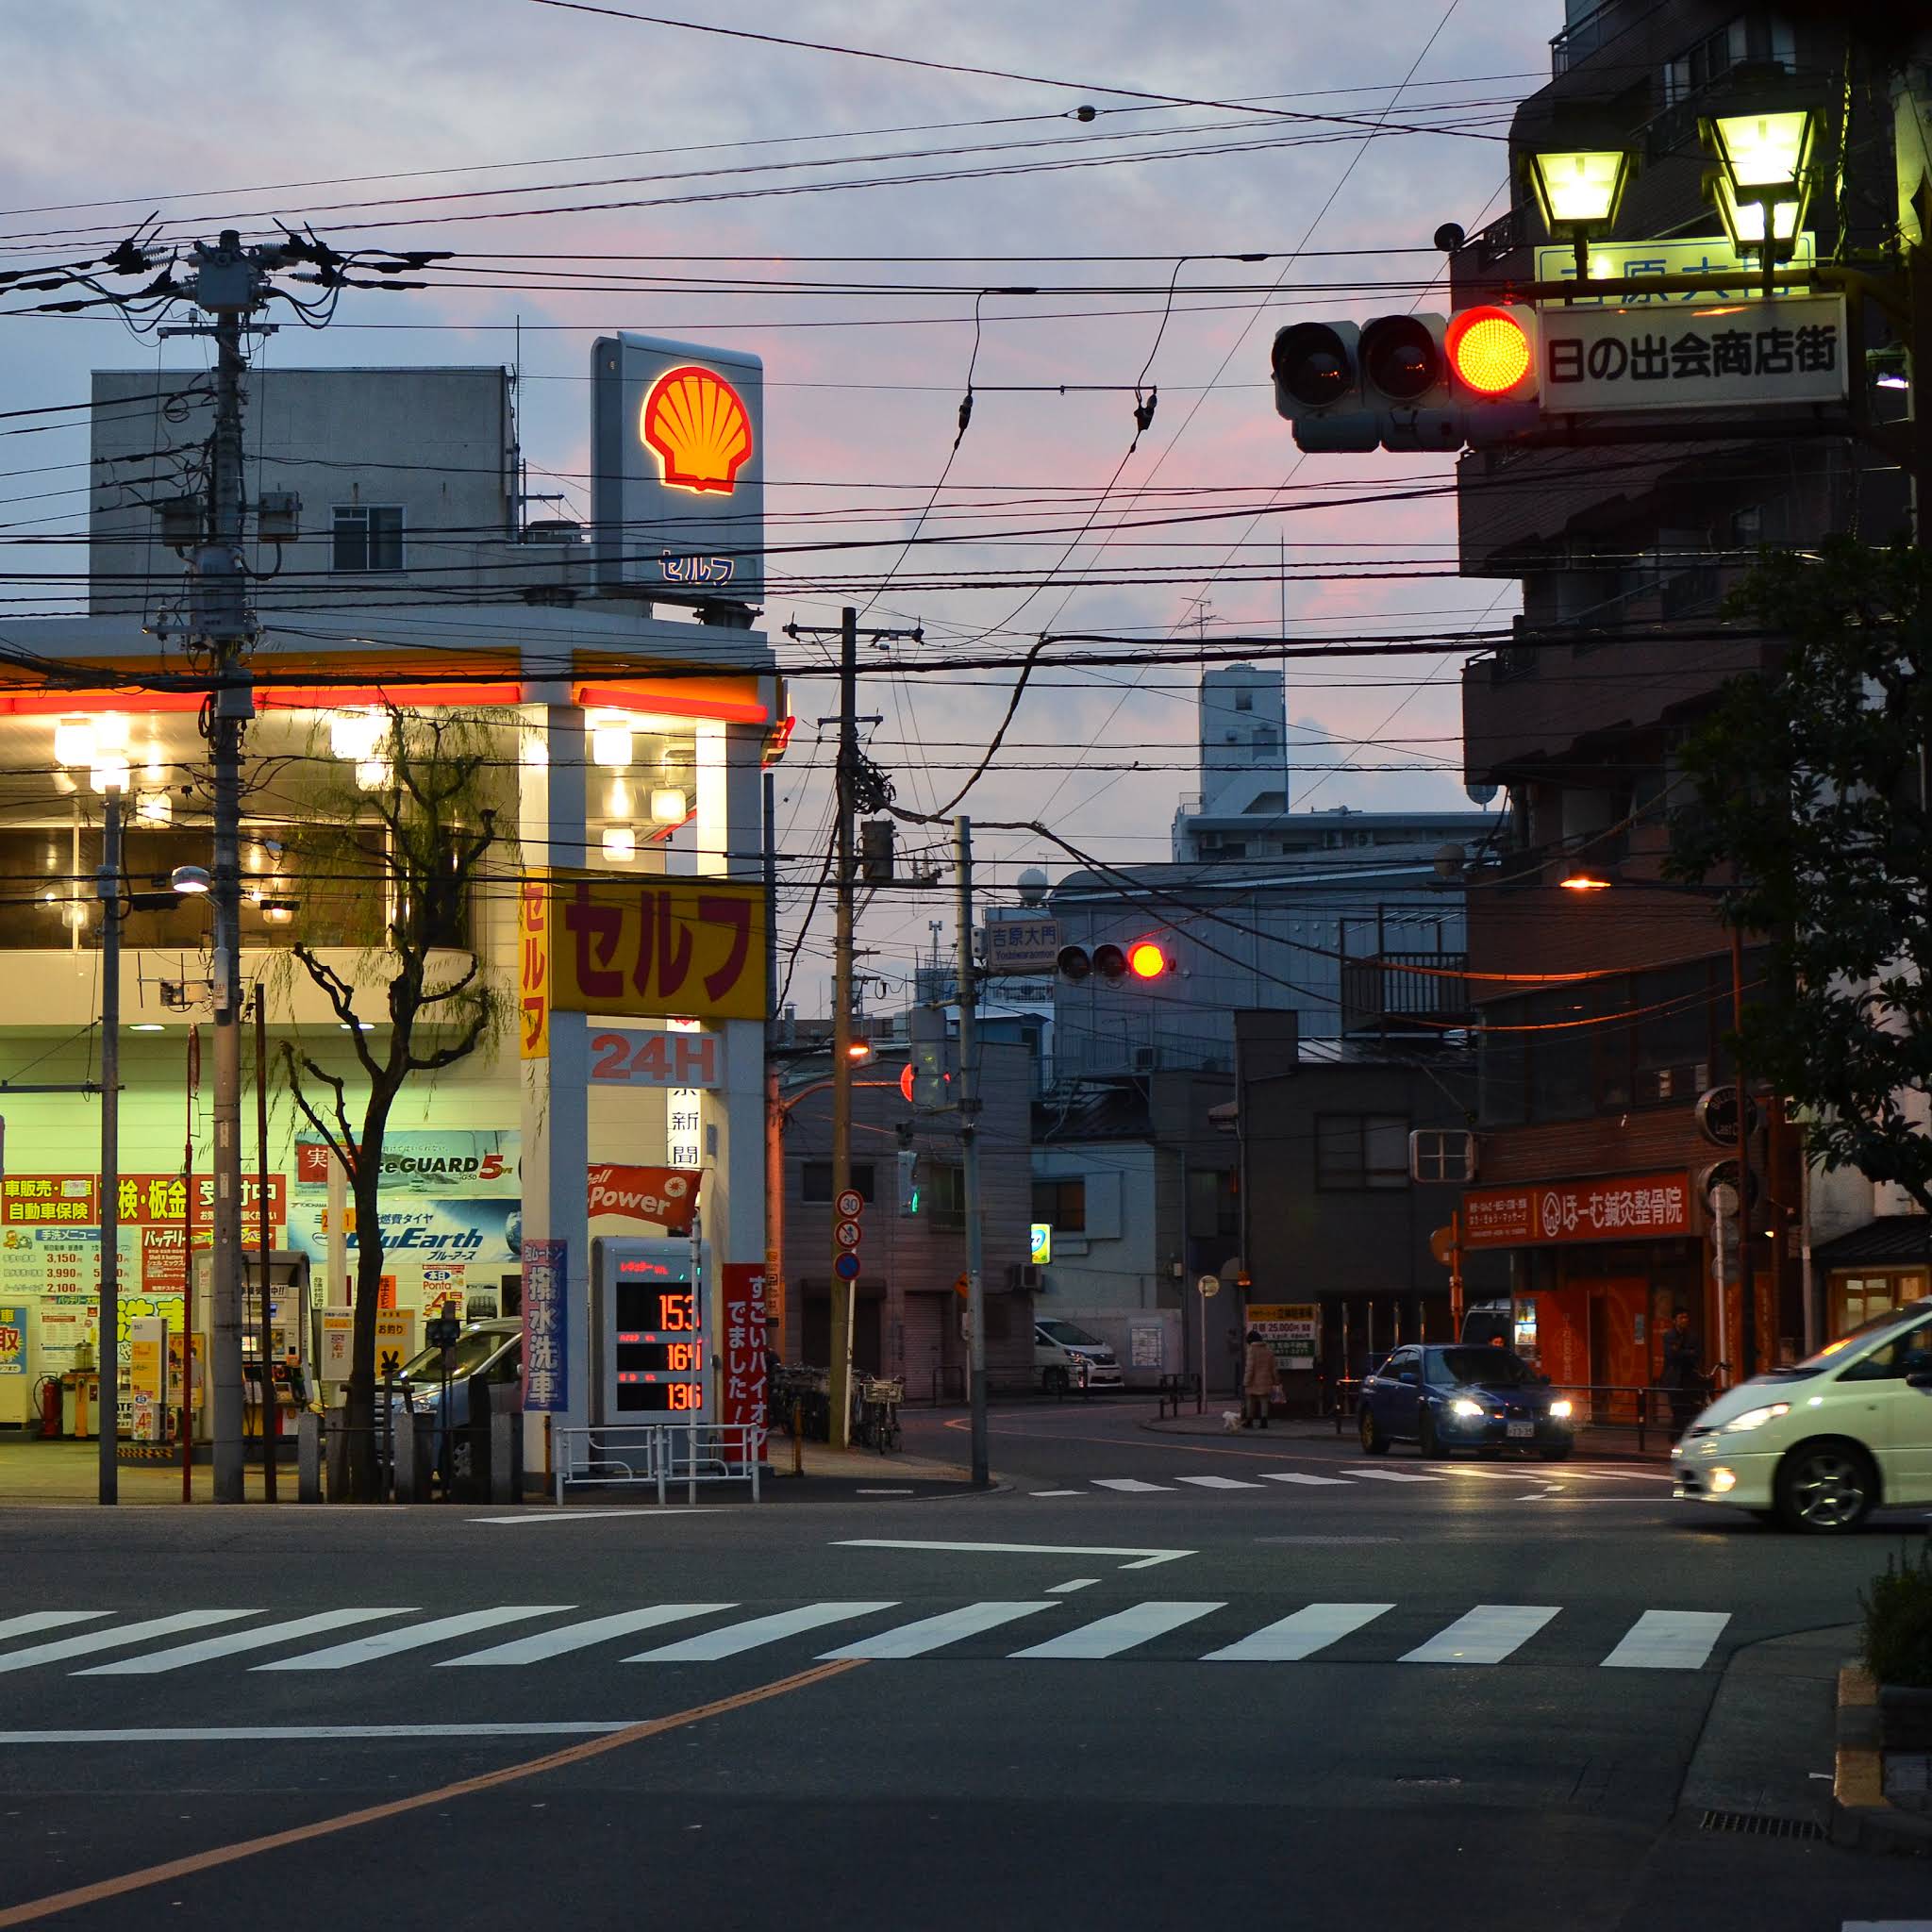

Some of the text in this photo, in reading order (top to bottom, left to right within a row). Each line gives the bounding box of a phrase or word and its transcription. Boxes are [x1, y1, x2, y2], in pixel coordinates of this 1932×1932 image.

[1548, 325, 1837, 383] 日の出会商店街
[658, 549, 734, 587] セルフ
[566, 883, 752, 1003] セルフ
[991, 926, 1056, 947] 吉原大門
[523, 877, 545, 1052] セルフ
[591, 1034, 714, 1083] 24H
[9, 1203, 88, 1220] 自動車保険
[99, 1179, 186, 1220] 検・板金
[843, 1198, 858, 1210] 30
[1563, 1187, 1682, 1230] ほーむ鍼灸整骨院
[345, 1213, 350, 1226] 1
[377, 1214, 433, 1224] 燃費タイヤ
[42, 1231, 97, 1240] 手洗メニュー
[427, 1252, 476, 1260] ブルーアース
[423, 1281, 451, 1291] Ponta
[659, 1295, 701, 1331] 153
[378, 1324, 404, 1334] お釣り
[528, 1266, 558, 1406] 撥水洗車
[668, 1344, 701, 1371] 164
[669, 1384, 701, 1409] 136
